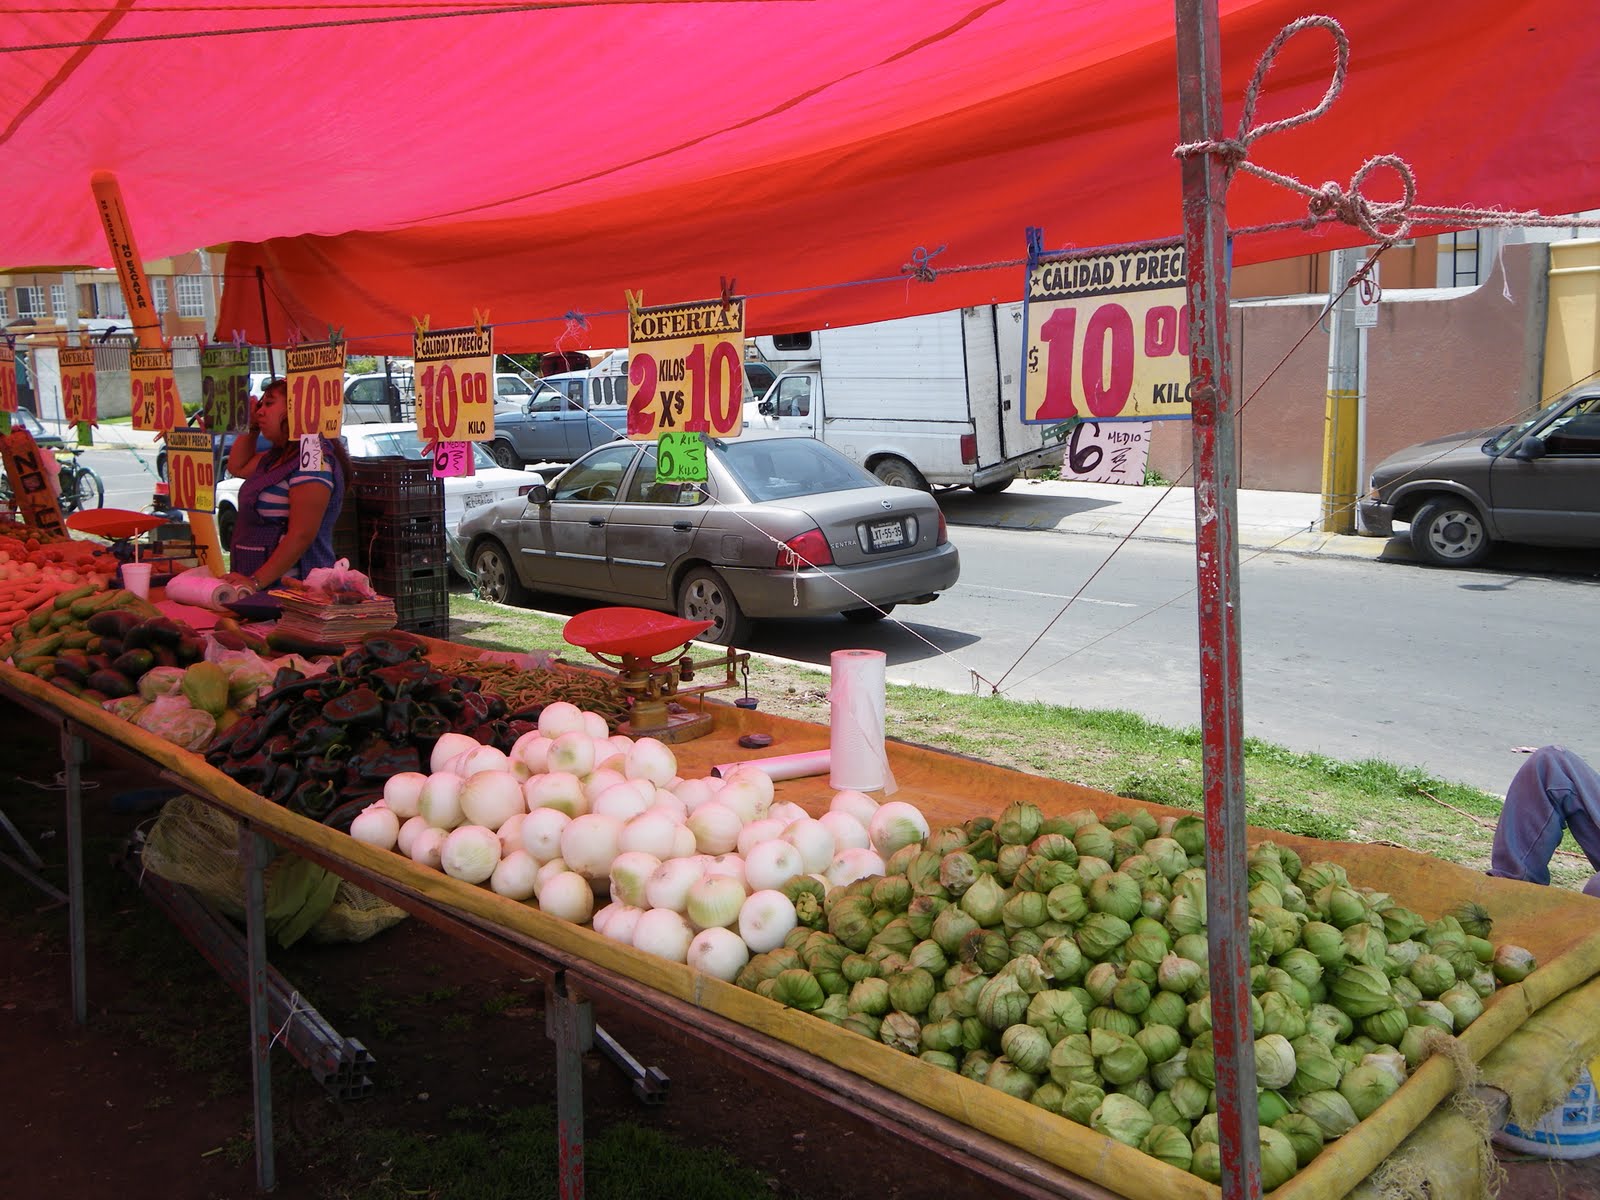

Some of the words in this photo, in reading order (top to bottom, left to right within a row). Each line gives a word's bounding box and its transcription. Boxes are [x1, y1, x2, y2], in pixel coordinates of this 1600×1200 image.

[121, 243, 133, 259] NO
[126, 260, 147, 309] EXCAVAR
[1042, 259, 1114, 291] CALIDAD
[1119, 259, 1132, 283] Y
[1136, 252, 1187, 281] PRECI
[641, 310, 730, 336] OFERTA
[62, 353, 91, 364] OFERTA
[421, 339, 449, 355] CALIDAD
[450, 338, 457, 353] Y
[457, 335, 483, 352] PRECIO
[136, 354, 169, 368] OFERTA
[292, 352, 315, 368] CALIDAD
[63, 374, 73, 421] 2
[80, 371, 97, 421] 12
[627, 353, 658, 435] 2
[659, 358, 685, 382] KILOS
[685, 341, 743, 434] 10
[132, 379, 143, 428] 2
[153, 376, 175, 430] 15
[203, 376, 215, 428] 2
[226, 375, 250, 431] 15
[326, 420, 337, 432] KILO
[468, 421, 486, 435] KILO
[301, 437, 311, 469] 6
[434, 441, 449, 471] 6
[657, 433, 674, 477] 6
[1069, 422, 1104, 475] 6
[1107, 431, 1142, 443] MEDIO
[678, 464, 699, 476] KILO
[830, 540, 857, 549] SENTRA
